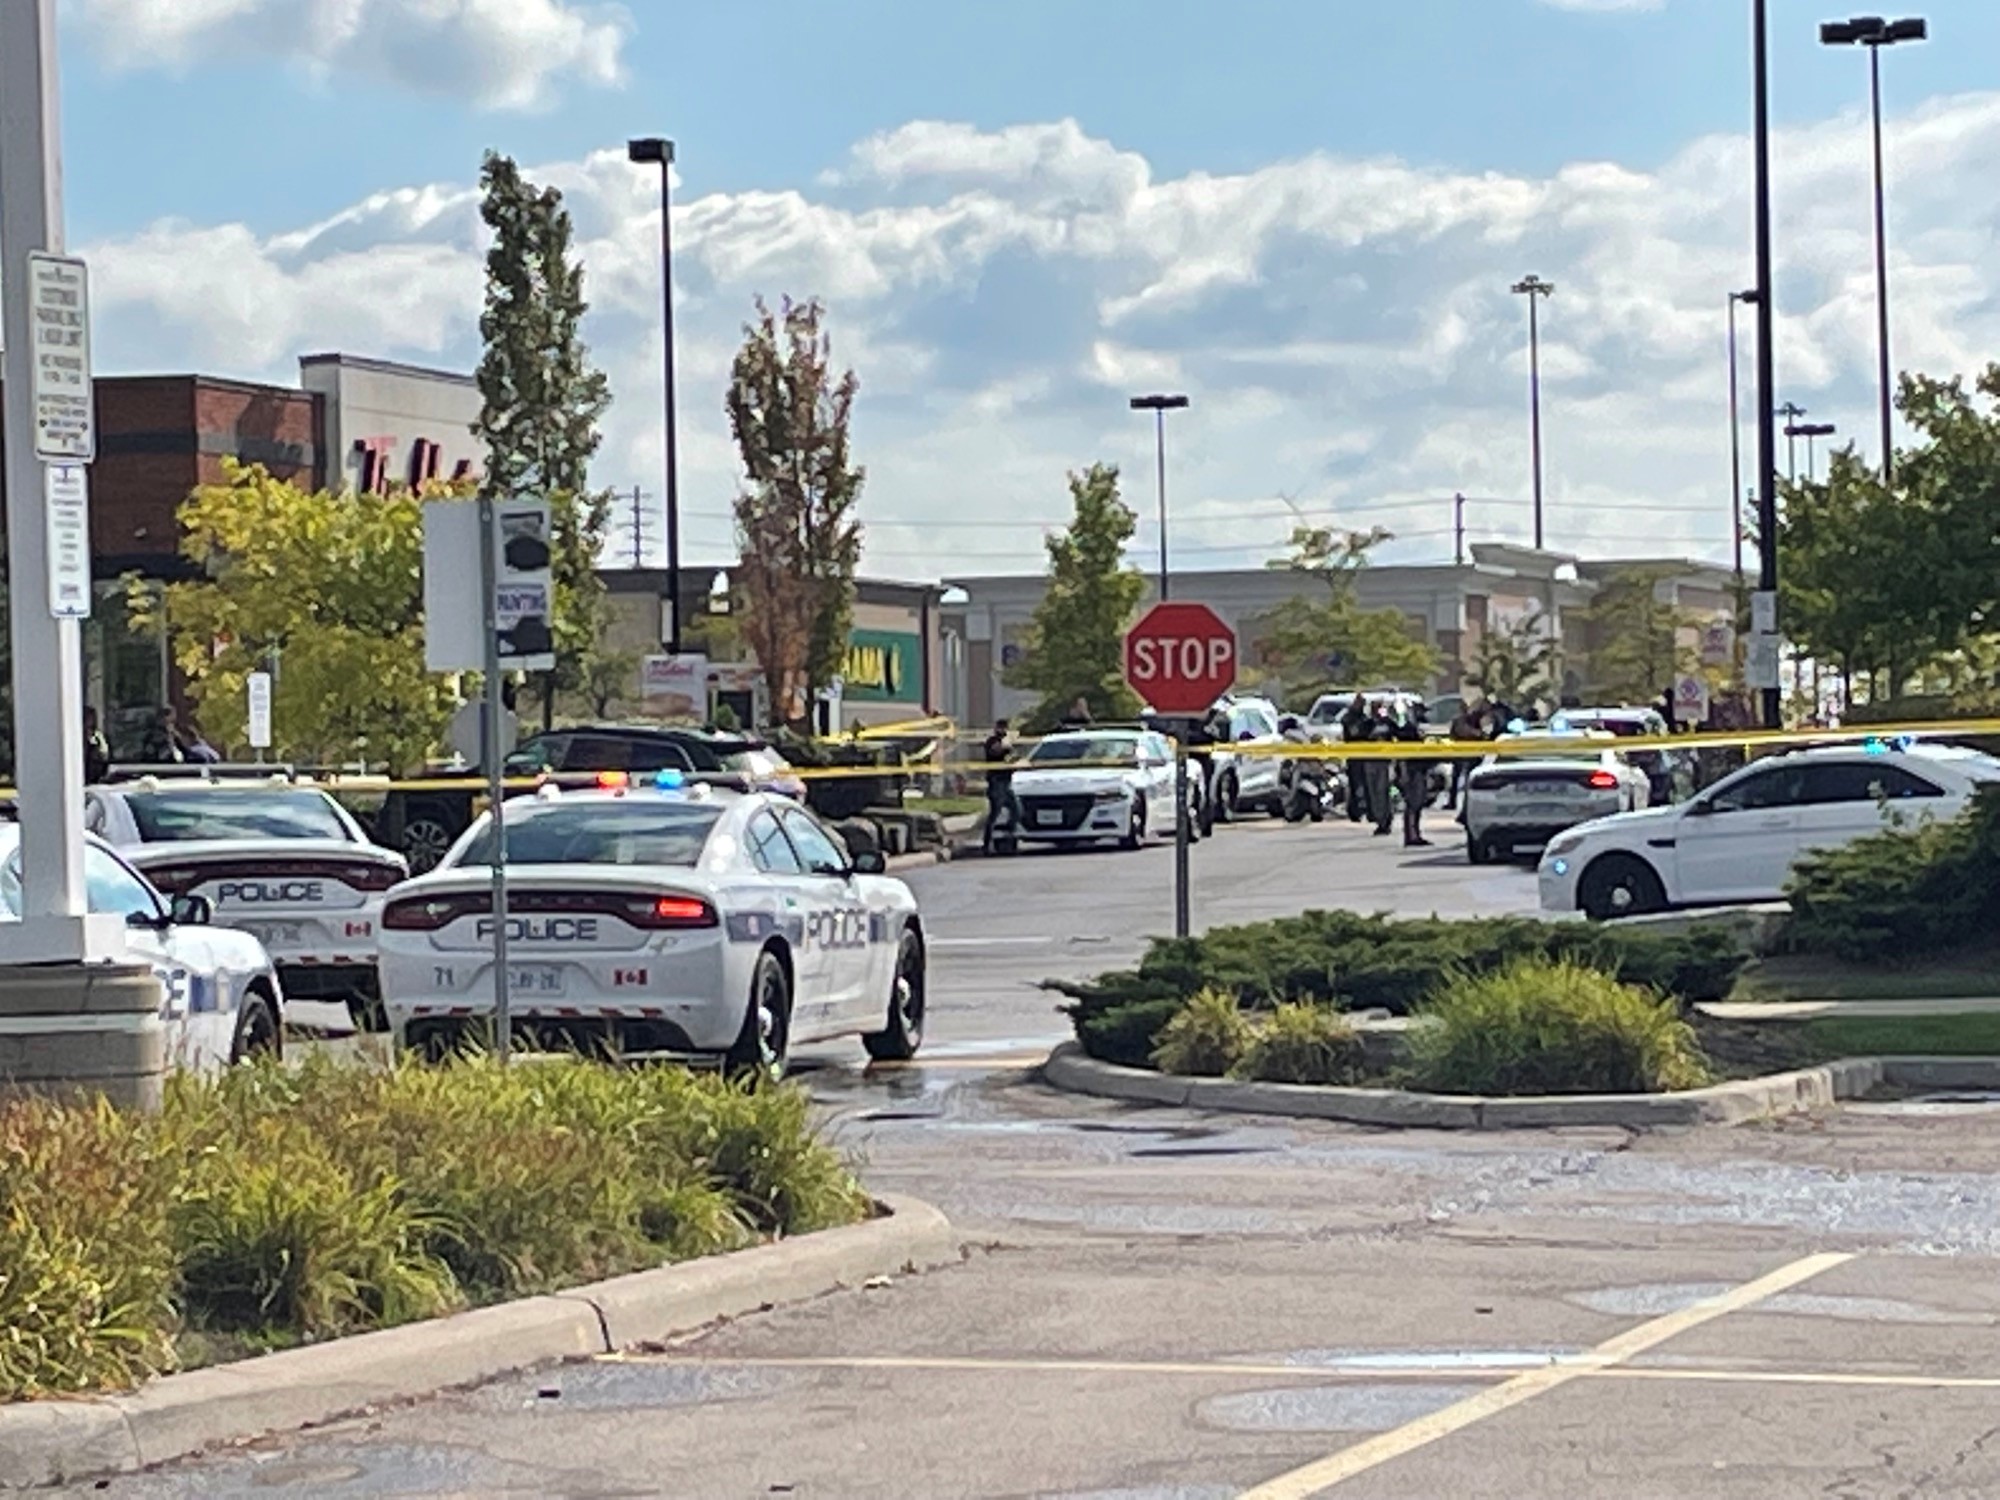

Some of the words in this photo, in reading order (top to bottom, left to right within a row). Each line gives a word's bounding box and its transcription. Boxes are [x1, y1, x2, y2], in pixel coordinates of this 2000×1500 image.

[1133, 637, 1232, 680] STOP
[218, 882, 324, 903] POLICE
[476, 918, 598, 941] POLICE
[433, 965, 455, 987] 71
